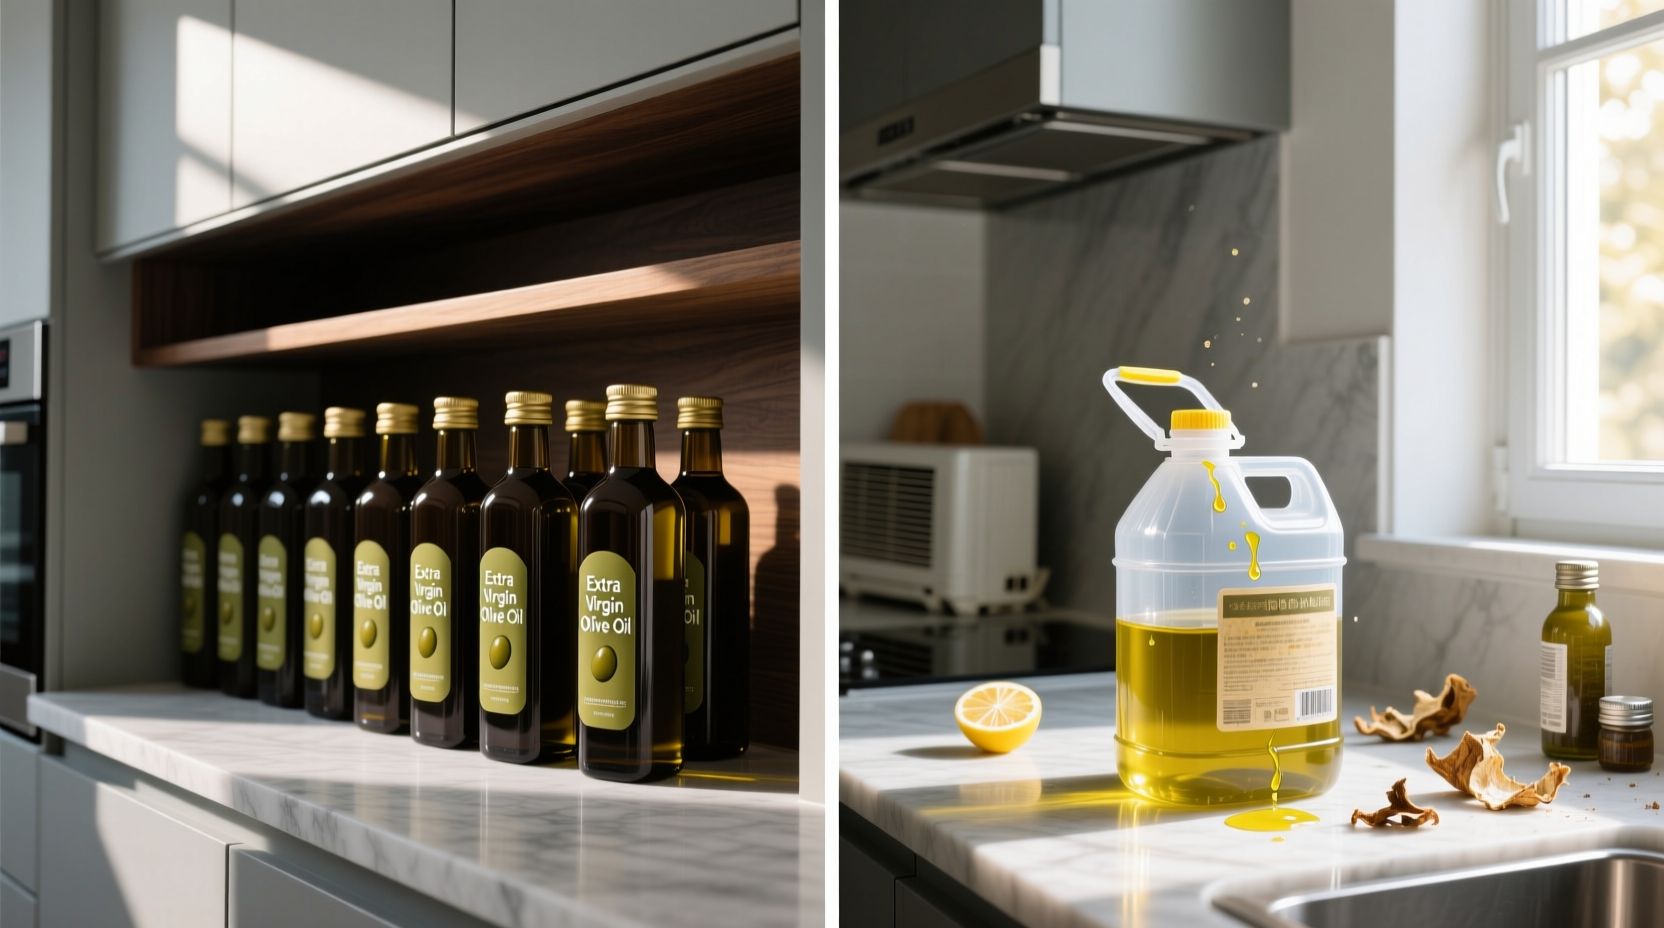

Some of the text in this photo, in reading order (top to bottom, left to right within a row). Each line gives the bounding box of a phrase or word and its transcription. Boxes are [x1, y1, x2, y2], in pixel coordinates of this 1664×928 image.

[485, 570, 514, 587] Extra
[586, 575, 621, 592] Extra
[483, 588, 517, 608] Virgin
[585, 594, 624, 616] Virgin
[506, 608, 523, 625] Oil
[580, 615, 631, 635] Olive Oil
